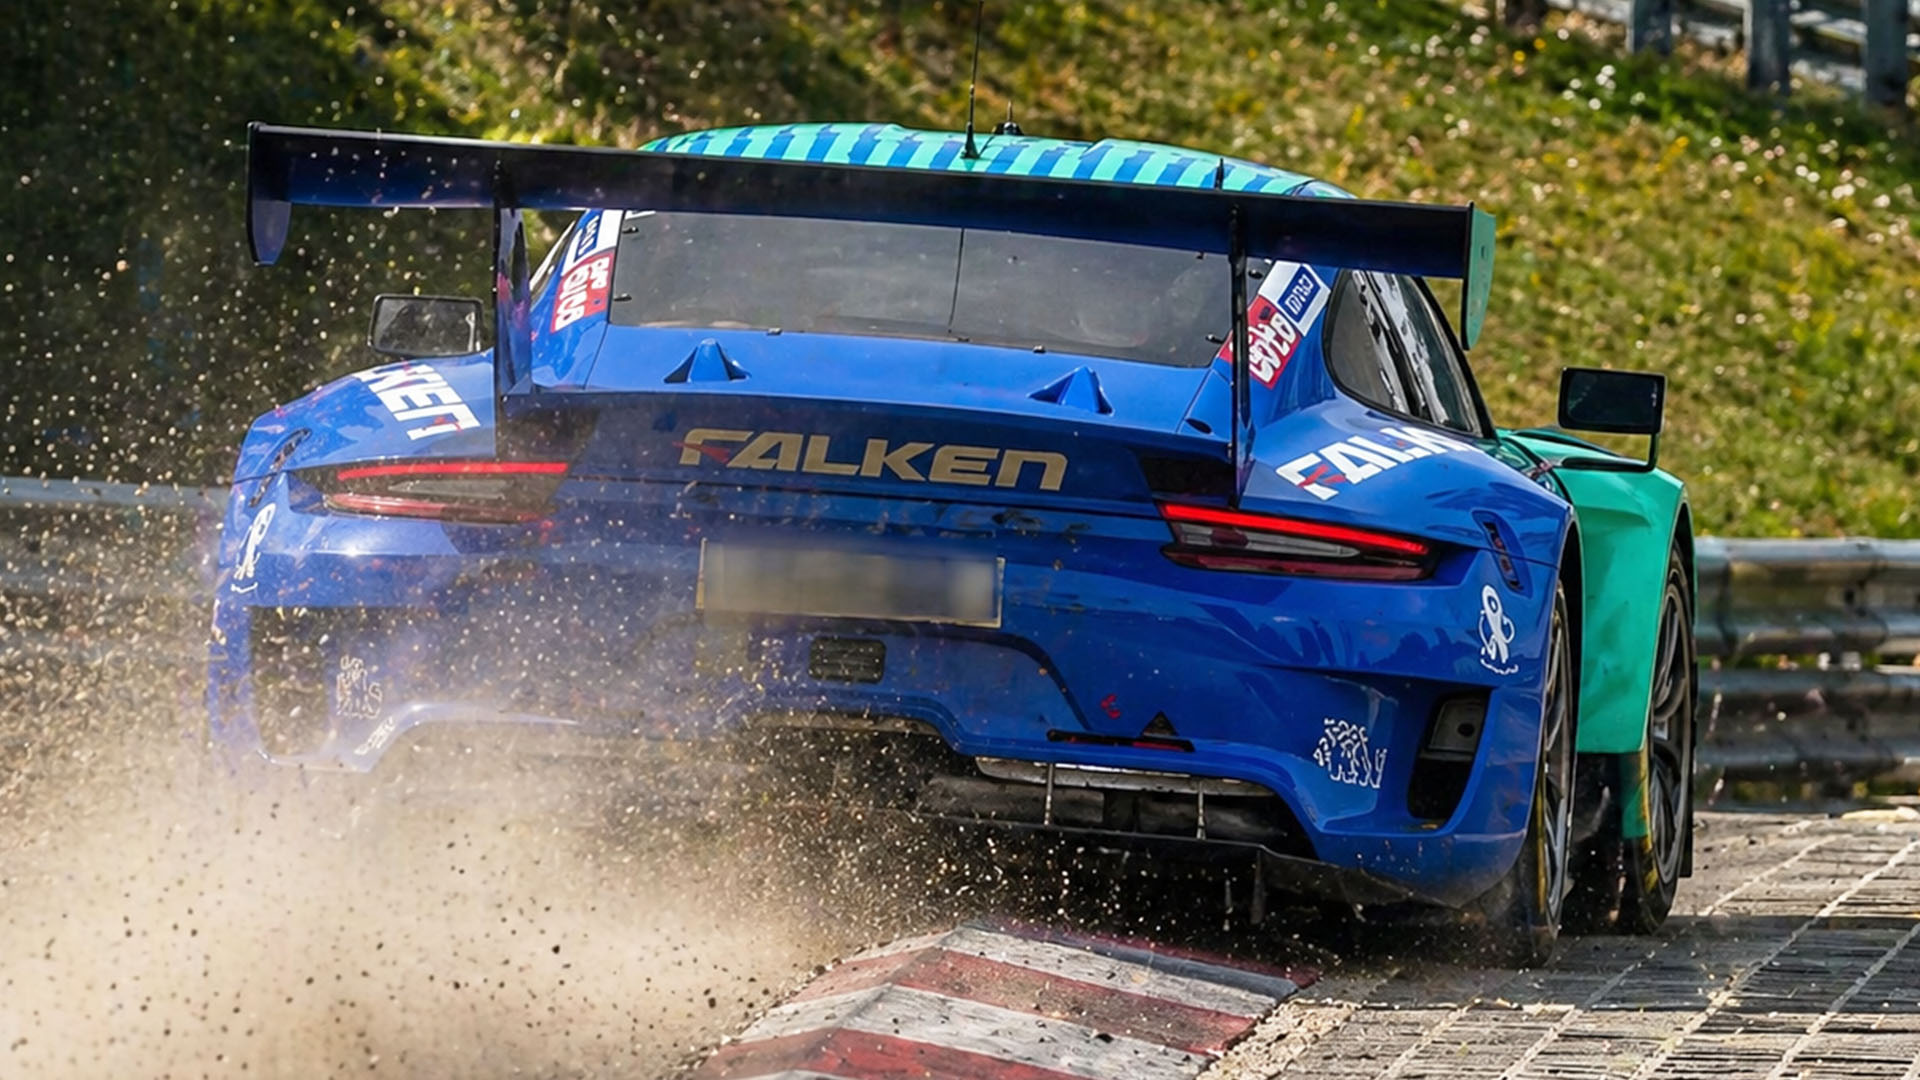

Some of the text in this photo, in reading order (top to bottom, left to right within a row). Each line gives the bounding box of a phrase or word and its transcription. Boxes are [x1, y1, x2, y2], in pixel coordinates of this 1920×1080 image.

[351, 362, 480, 440] KEN
[676, 428, 1068, 491] FALKEN
[1276, 427, 1484, 500] FALK
